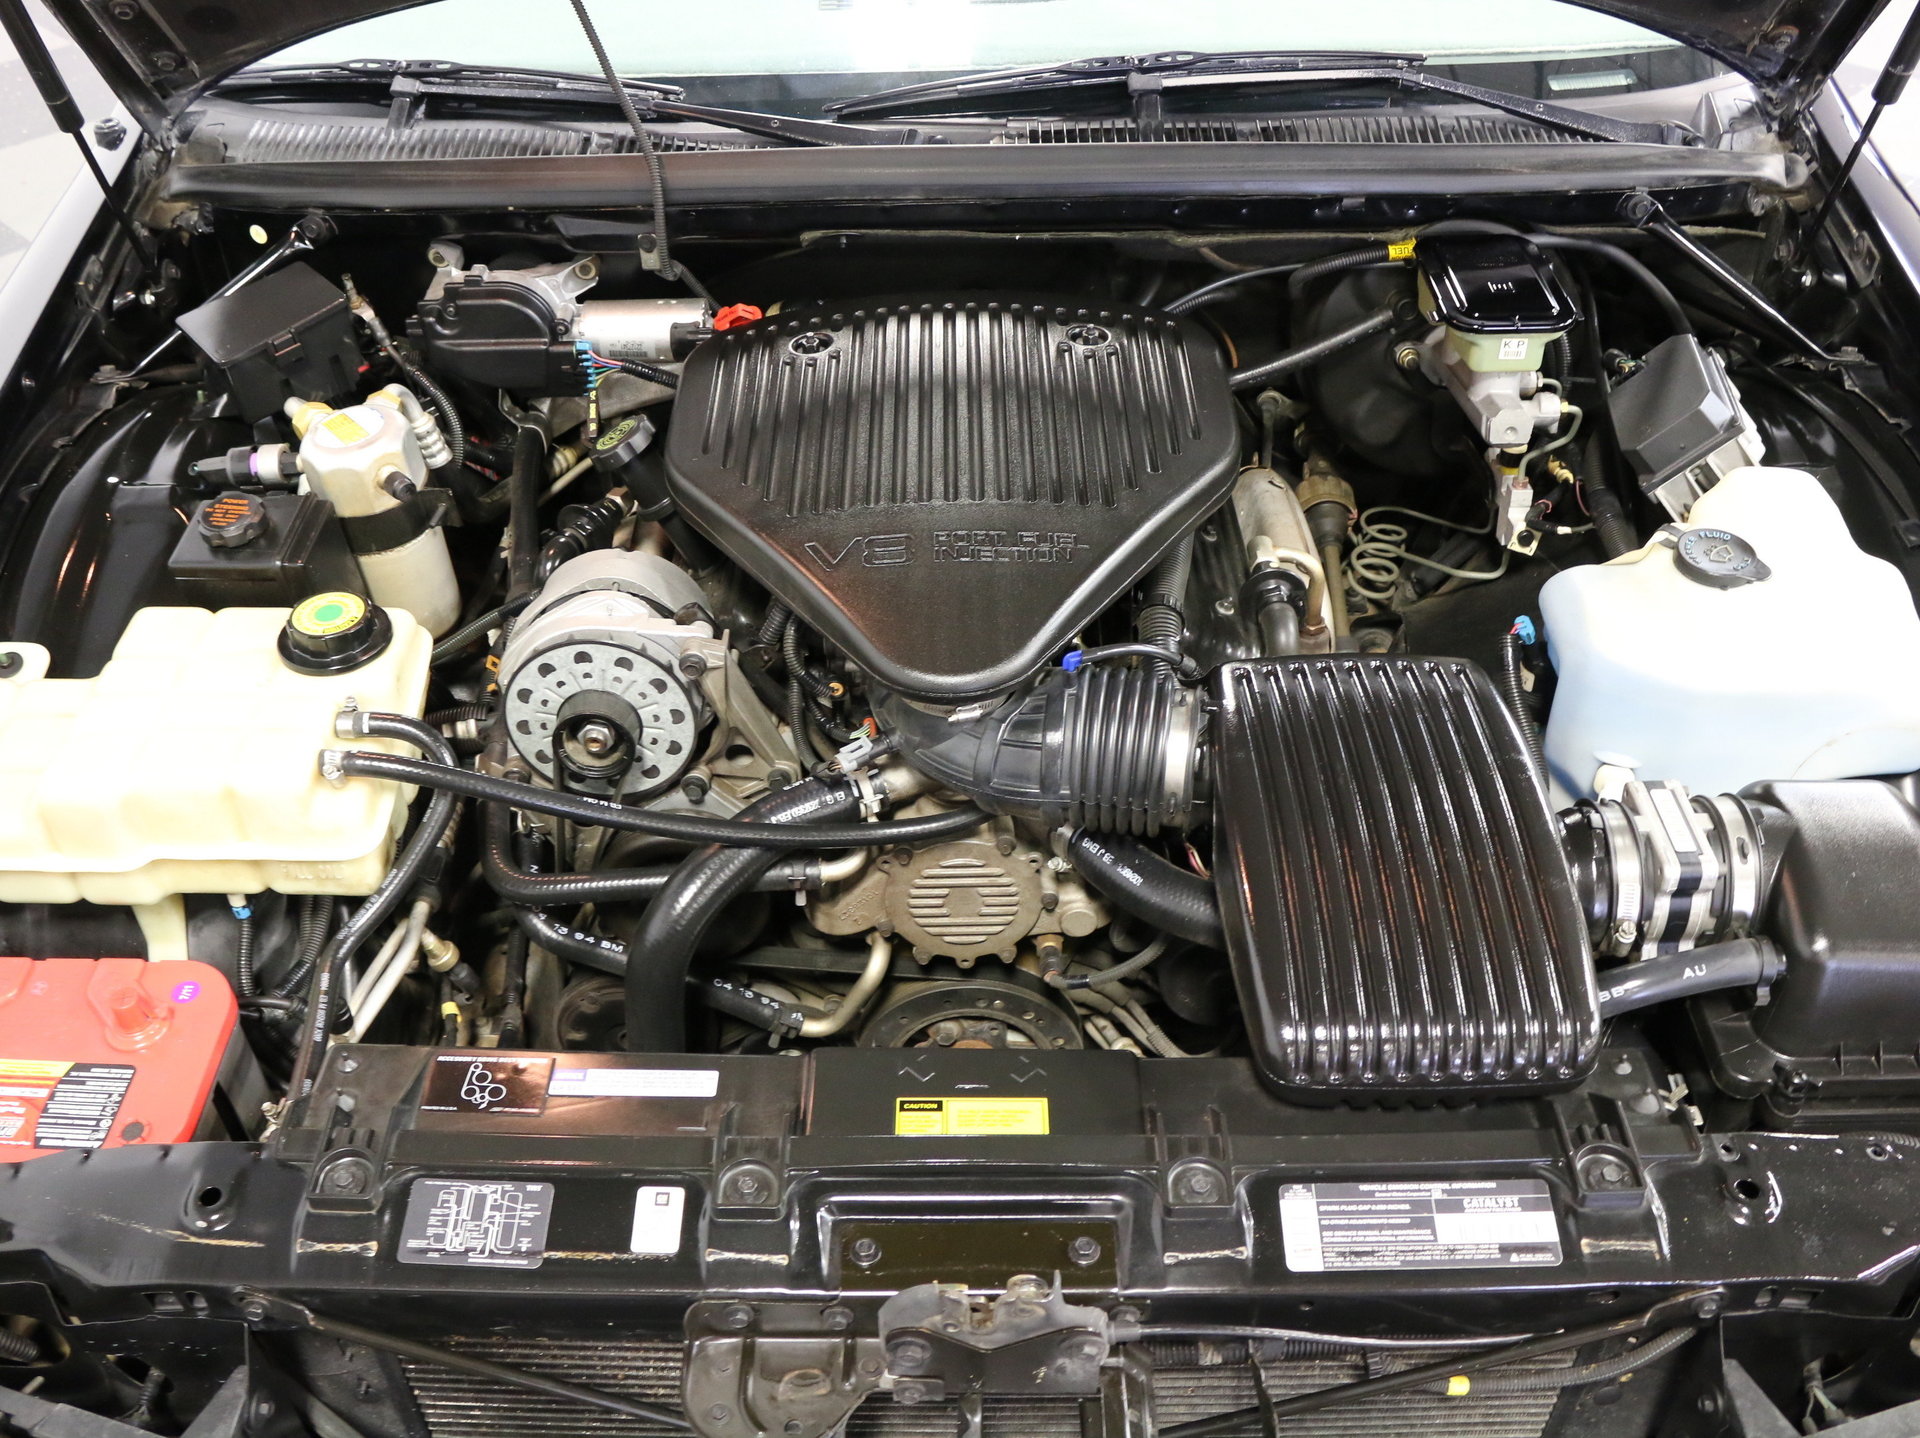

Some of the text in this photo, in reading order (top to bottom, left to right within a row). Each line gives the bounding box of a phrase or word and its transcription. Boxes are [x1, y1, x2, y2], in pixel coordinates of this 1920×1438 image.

[934, 531, 1090, 548] PORT FUEL
[1699, 530, 1732, 542] FLUID
[804, 533, 915, 571] V8
[934, 546, 1074, 563] INJECTION
[600, 939, 624, 953] BM
[1682, 963, 1707, 980] AU
[1463, 1197, 1520, 1208] CATALYST
